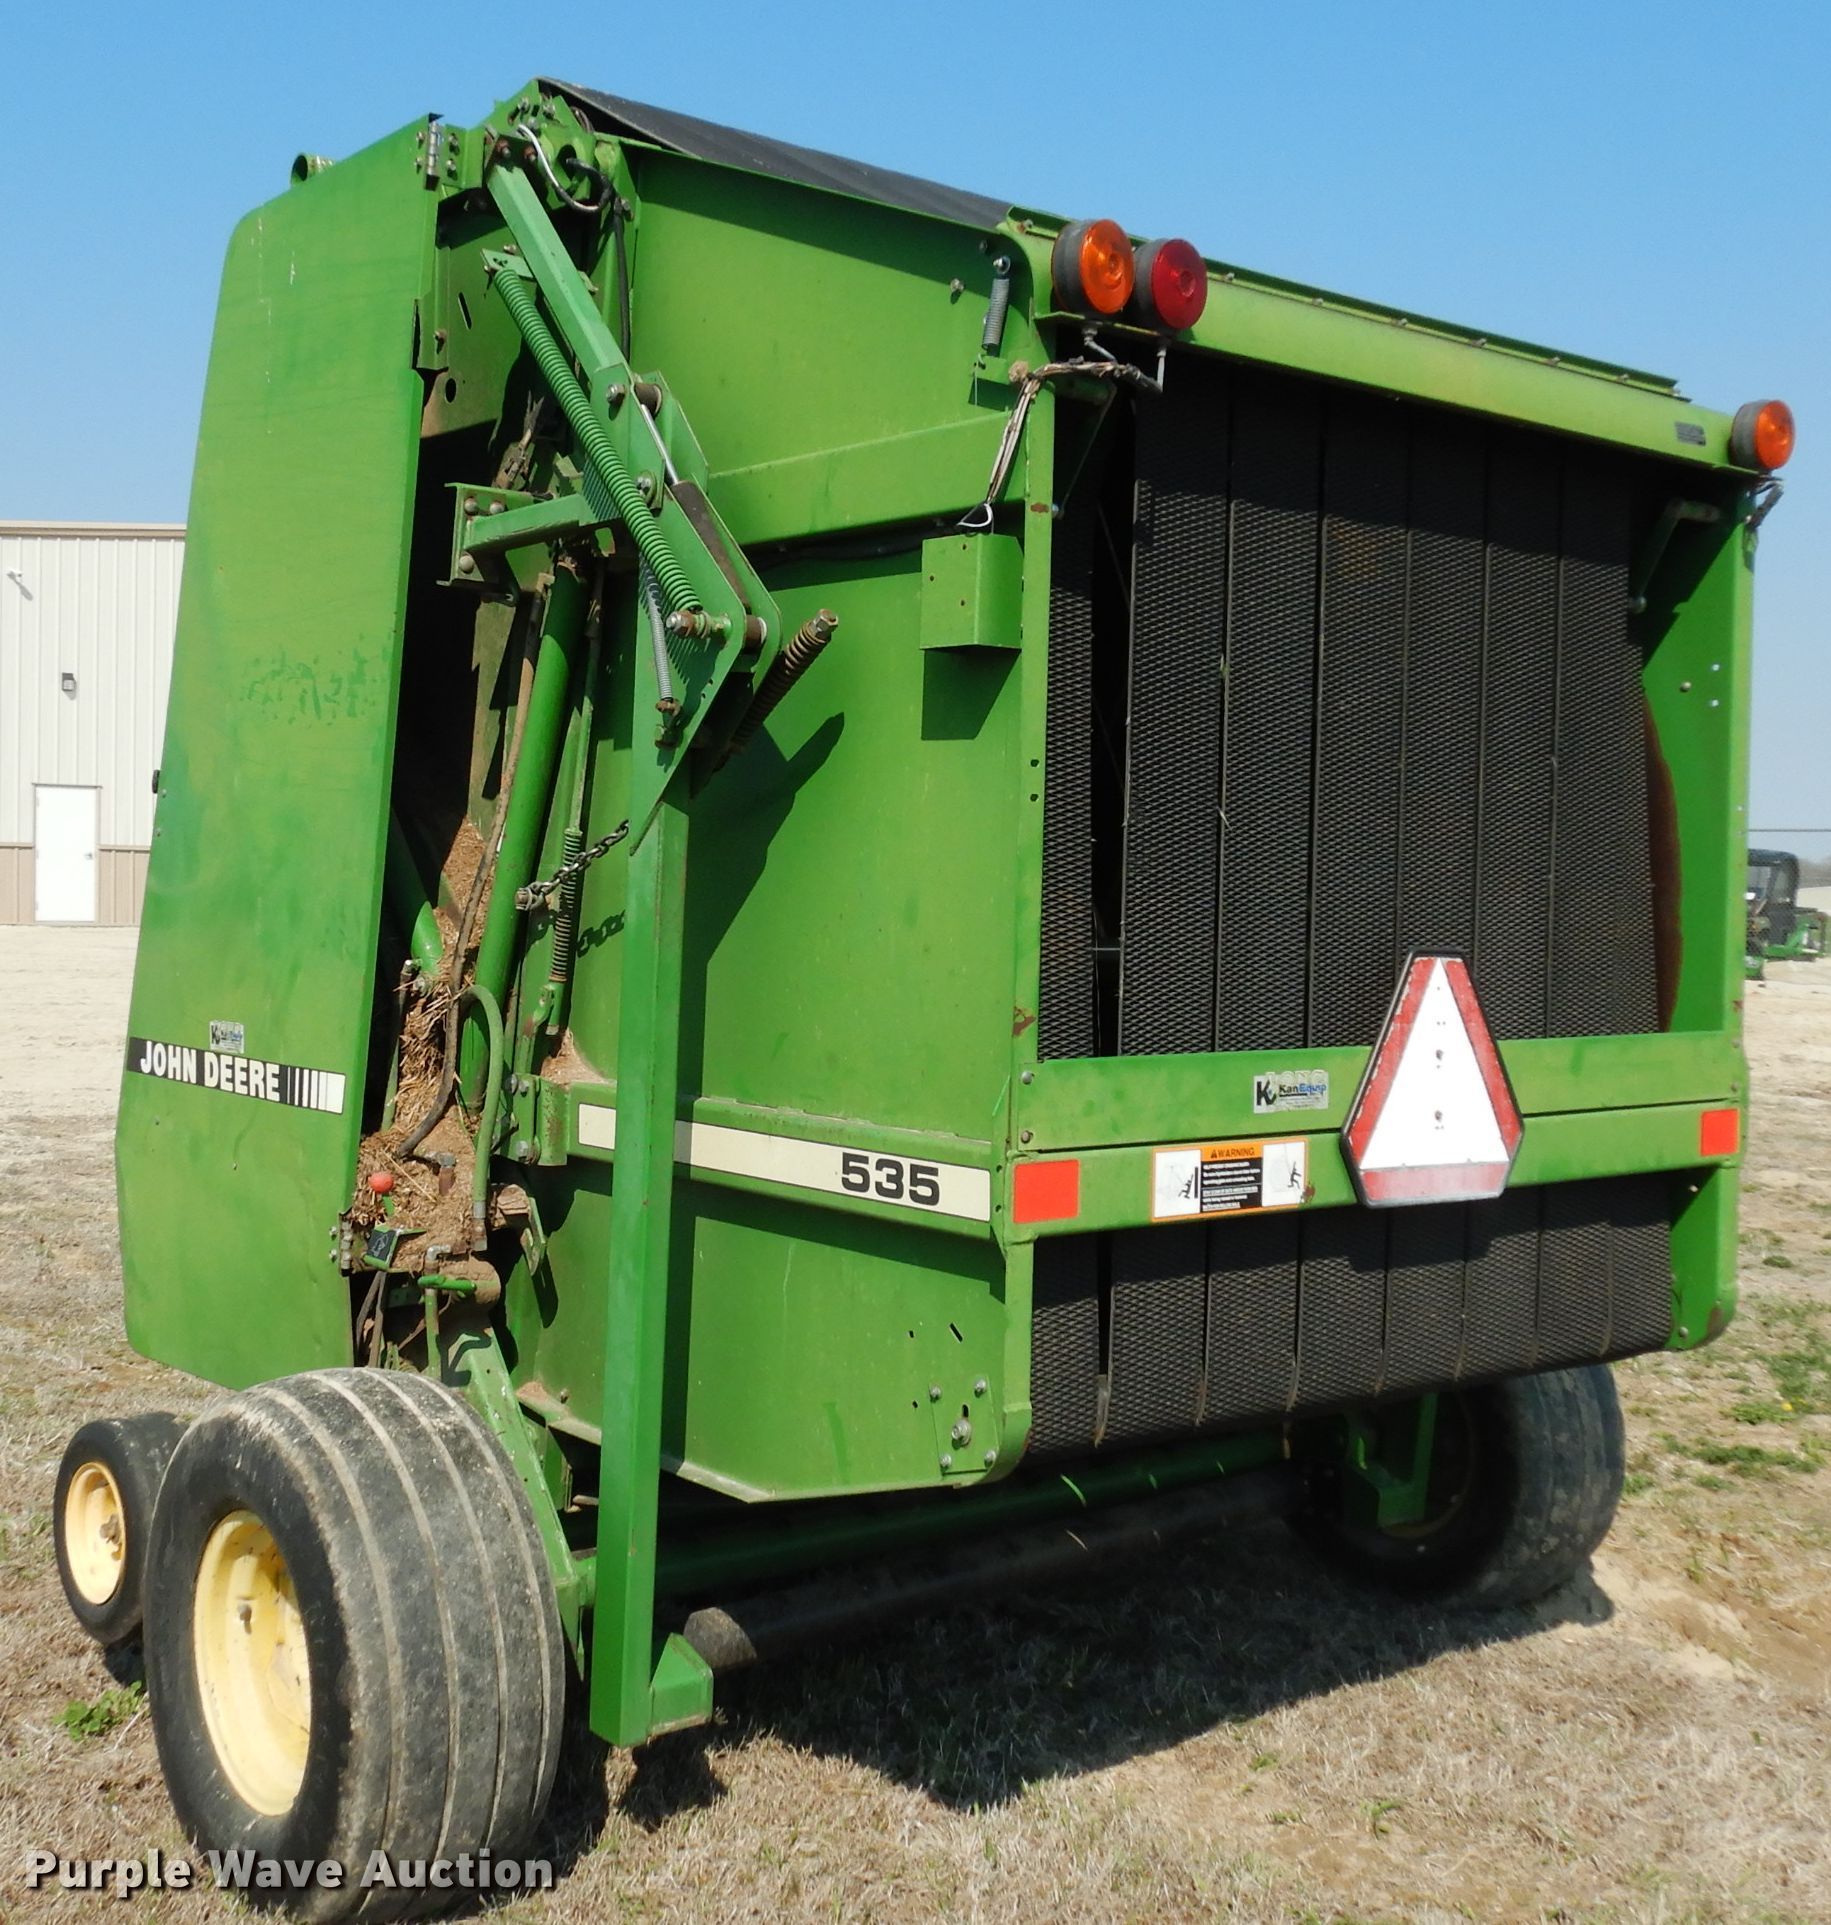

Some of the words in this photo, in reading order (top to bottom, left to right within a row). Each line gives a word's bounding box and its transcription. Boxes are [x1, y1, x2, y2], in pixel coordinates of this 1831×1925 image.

[140, 1040, 197, 1085] JOHN
[203, 1051, 281, 1102] DEERE
[1279, 1083, 1327, 1096] KanEquip
[1217, 1146, 1256, 1159] WARNING
[841, 1152, 940, 1206] 535
